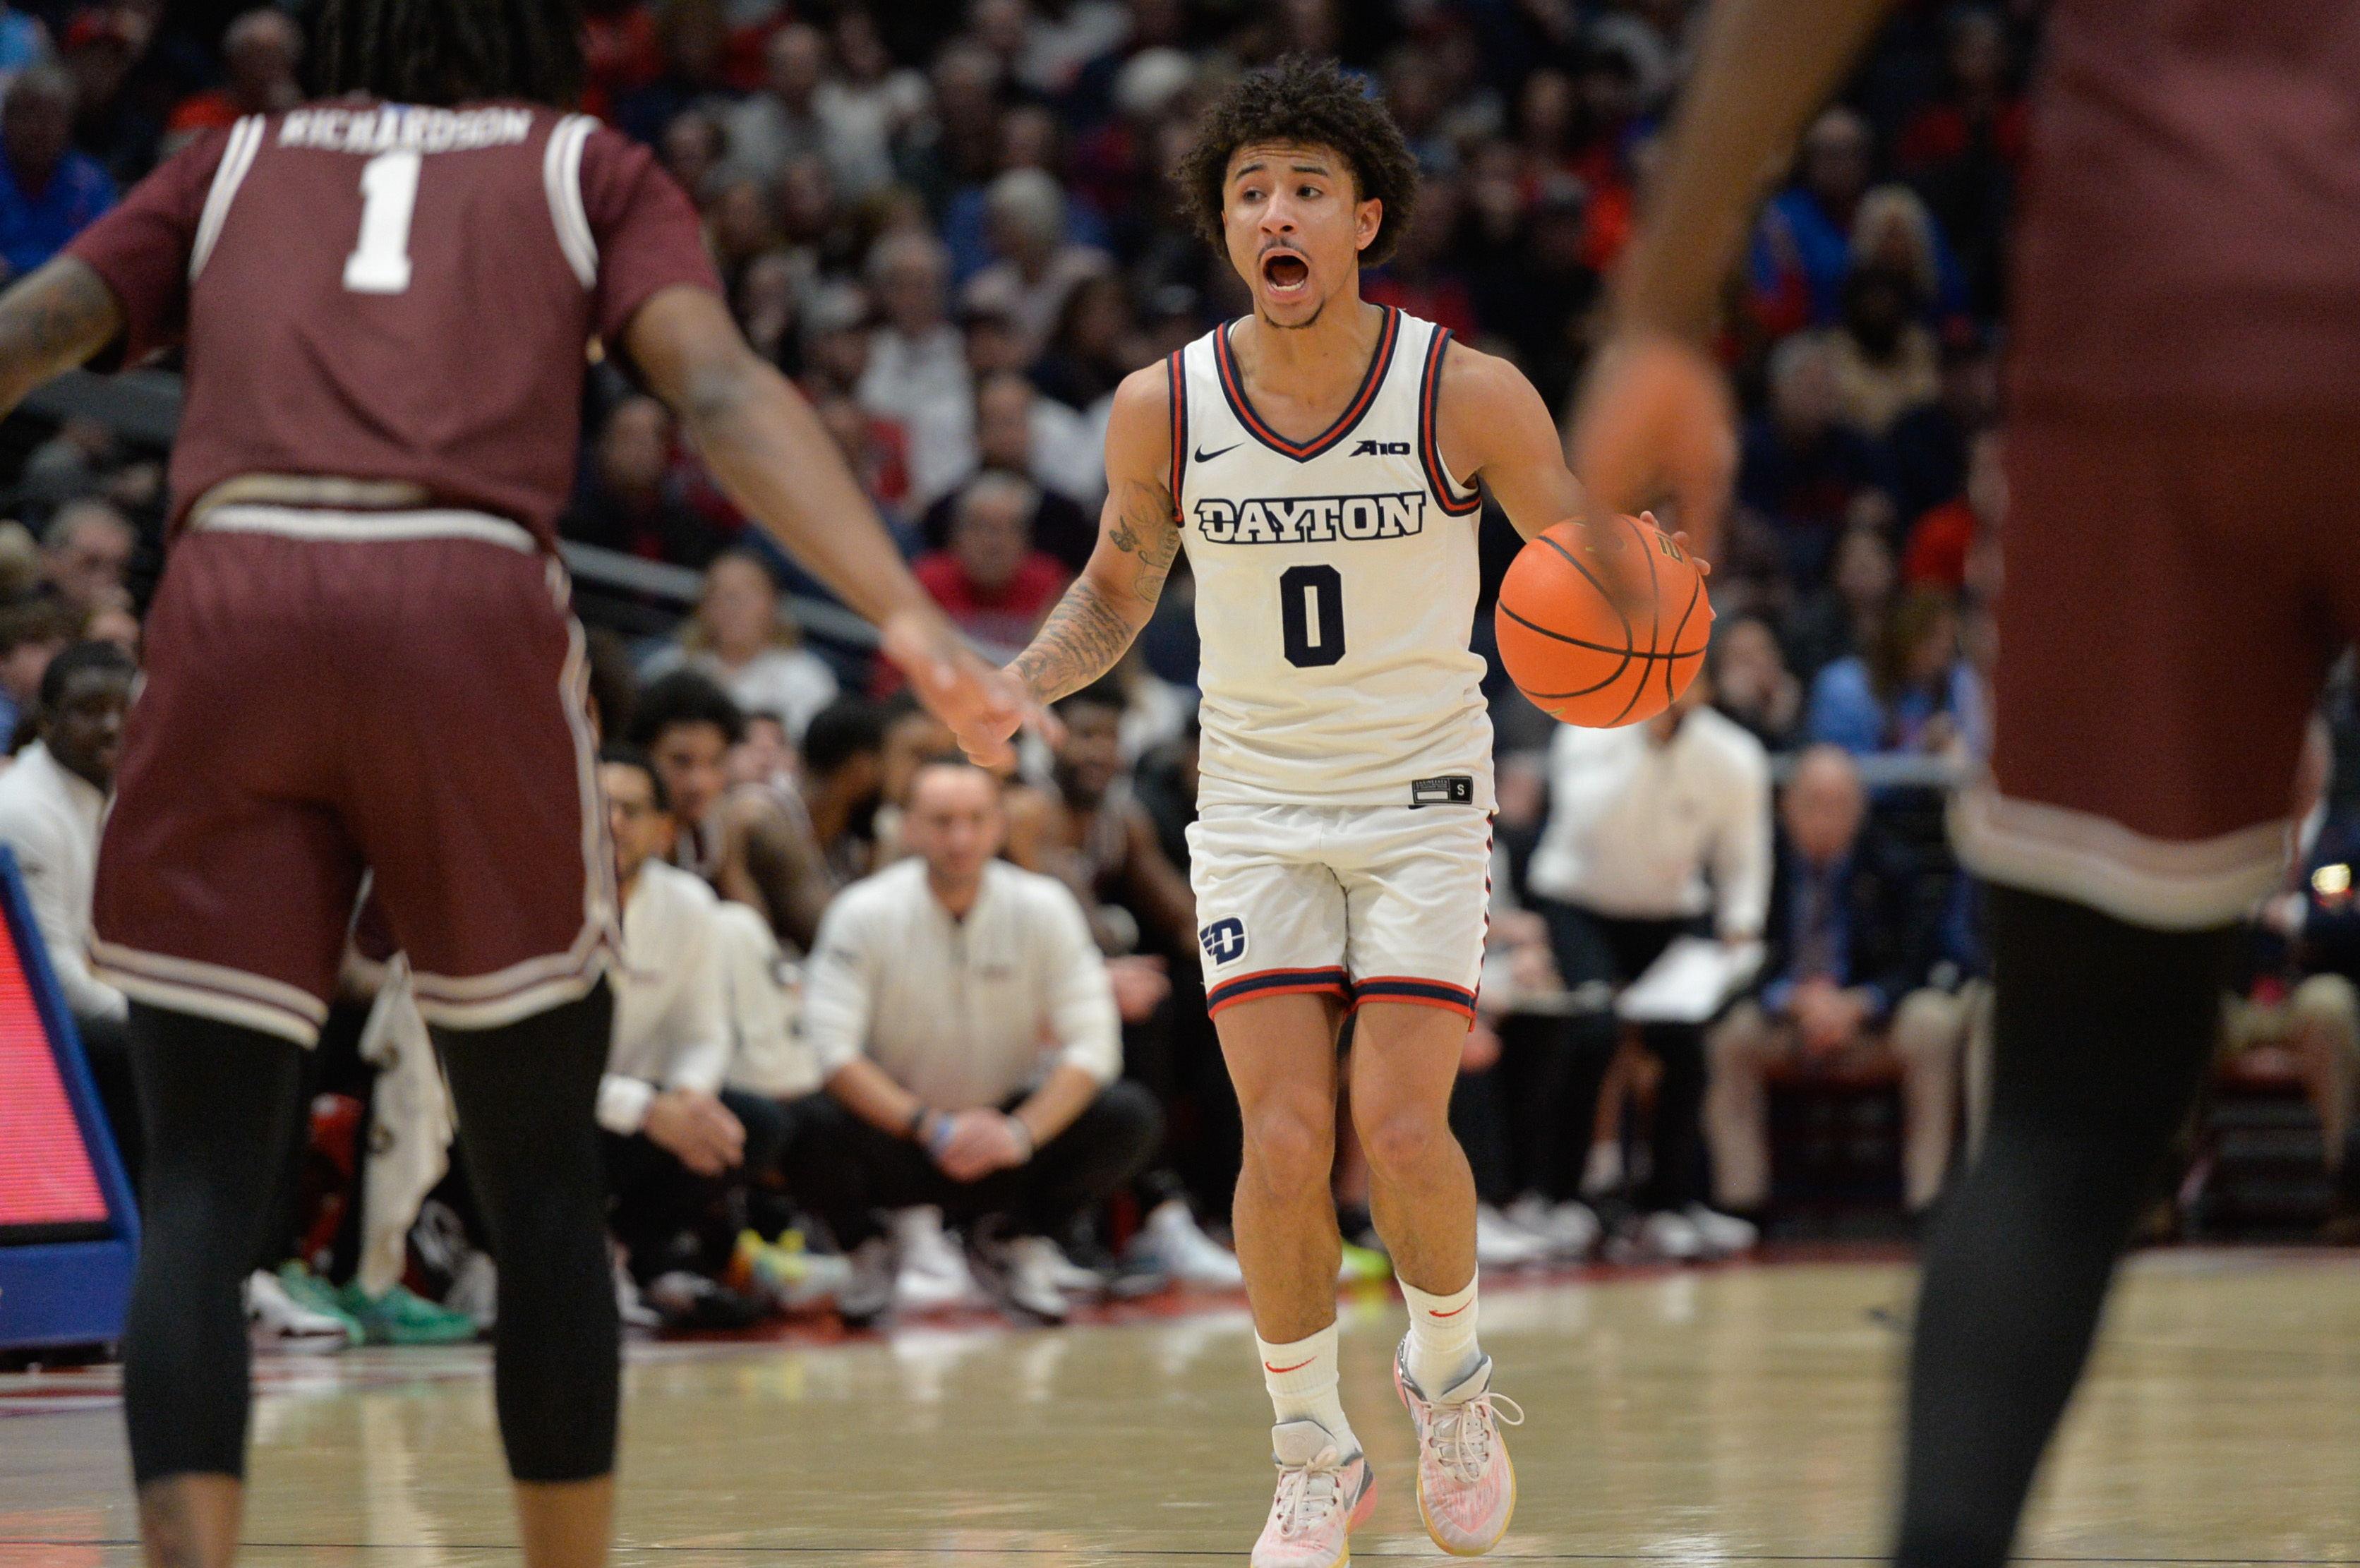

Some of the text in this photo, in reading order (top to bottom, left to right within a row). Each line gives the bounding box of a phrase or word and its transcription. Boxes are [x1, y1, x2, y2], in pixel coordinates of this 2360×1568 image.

[278, 106, 534, 154] RICHARDSON
[342, 149, 421, 294] 1
[1349, 440, 1411, 457] A10
[1193, 490, 1426, 544] DAYTON
[1280, 564, 1346, 668] 0
[1457, 784, 1465, 796] S
